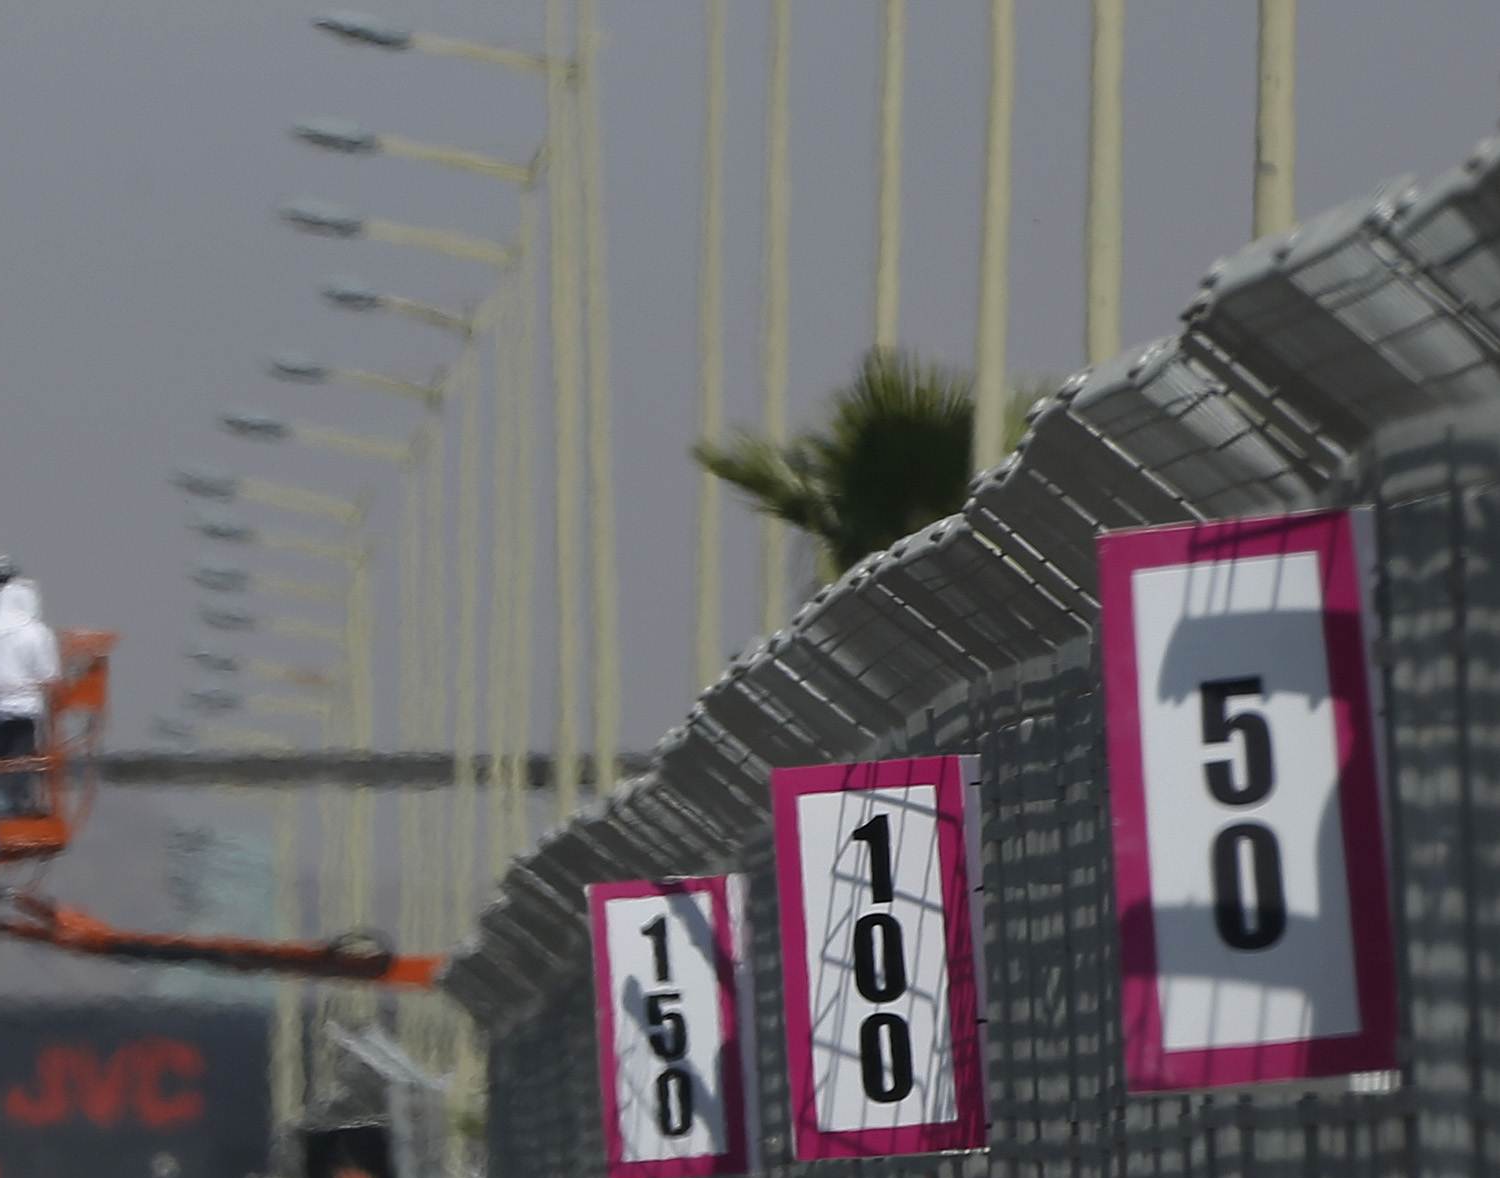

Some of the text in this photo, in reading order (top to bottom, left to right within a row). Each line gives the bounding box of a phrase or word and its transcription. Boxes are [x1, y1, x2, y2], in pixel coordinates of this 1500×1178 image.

[1198, 676, 1287, 954] 50
[4, 1036, 206, 1130] JVC
[640, 914, 693, 1138] 150
[852, 814, 913, 1104] 100
